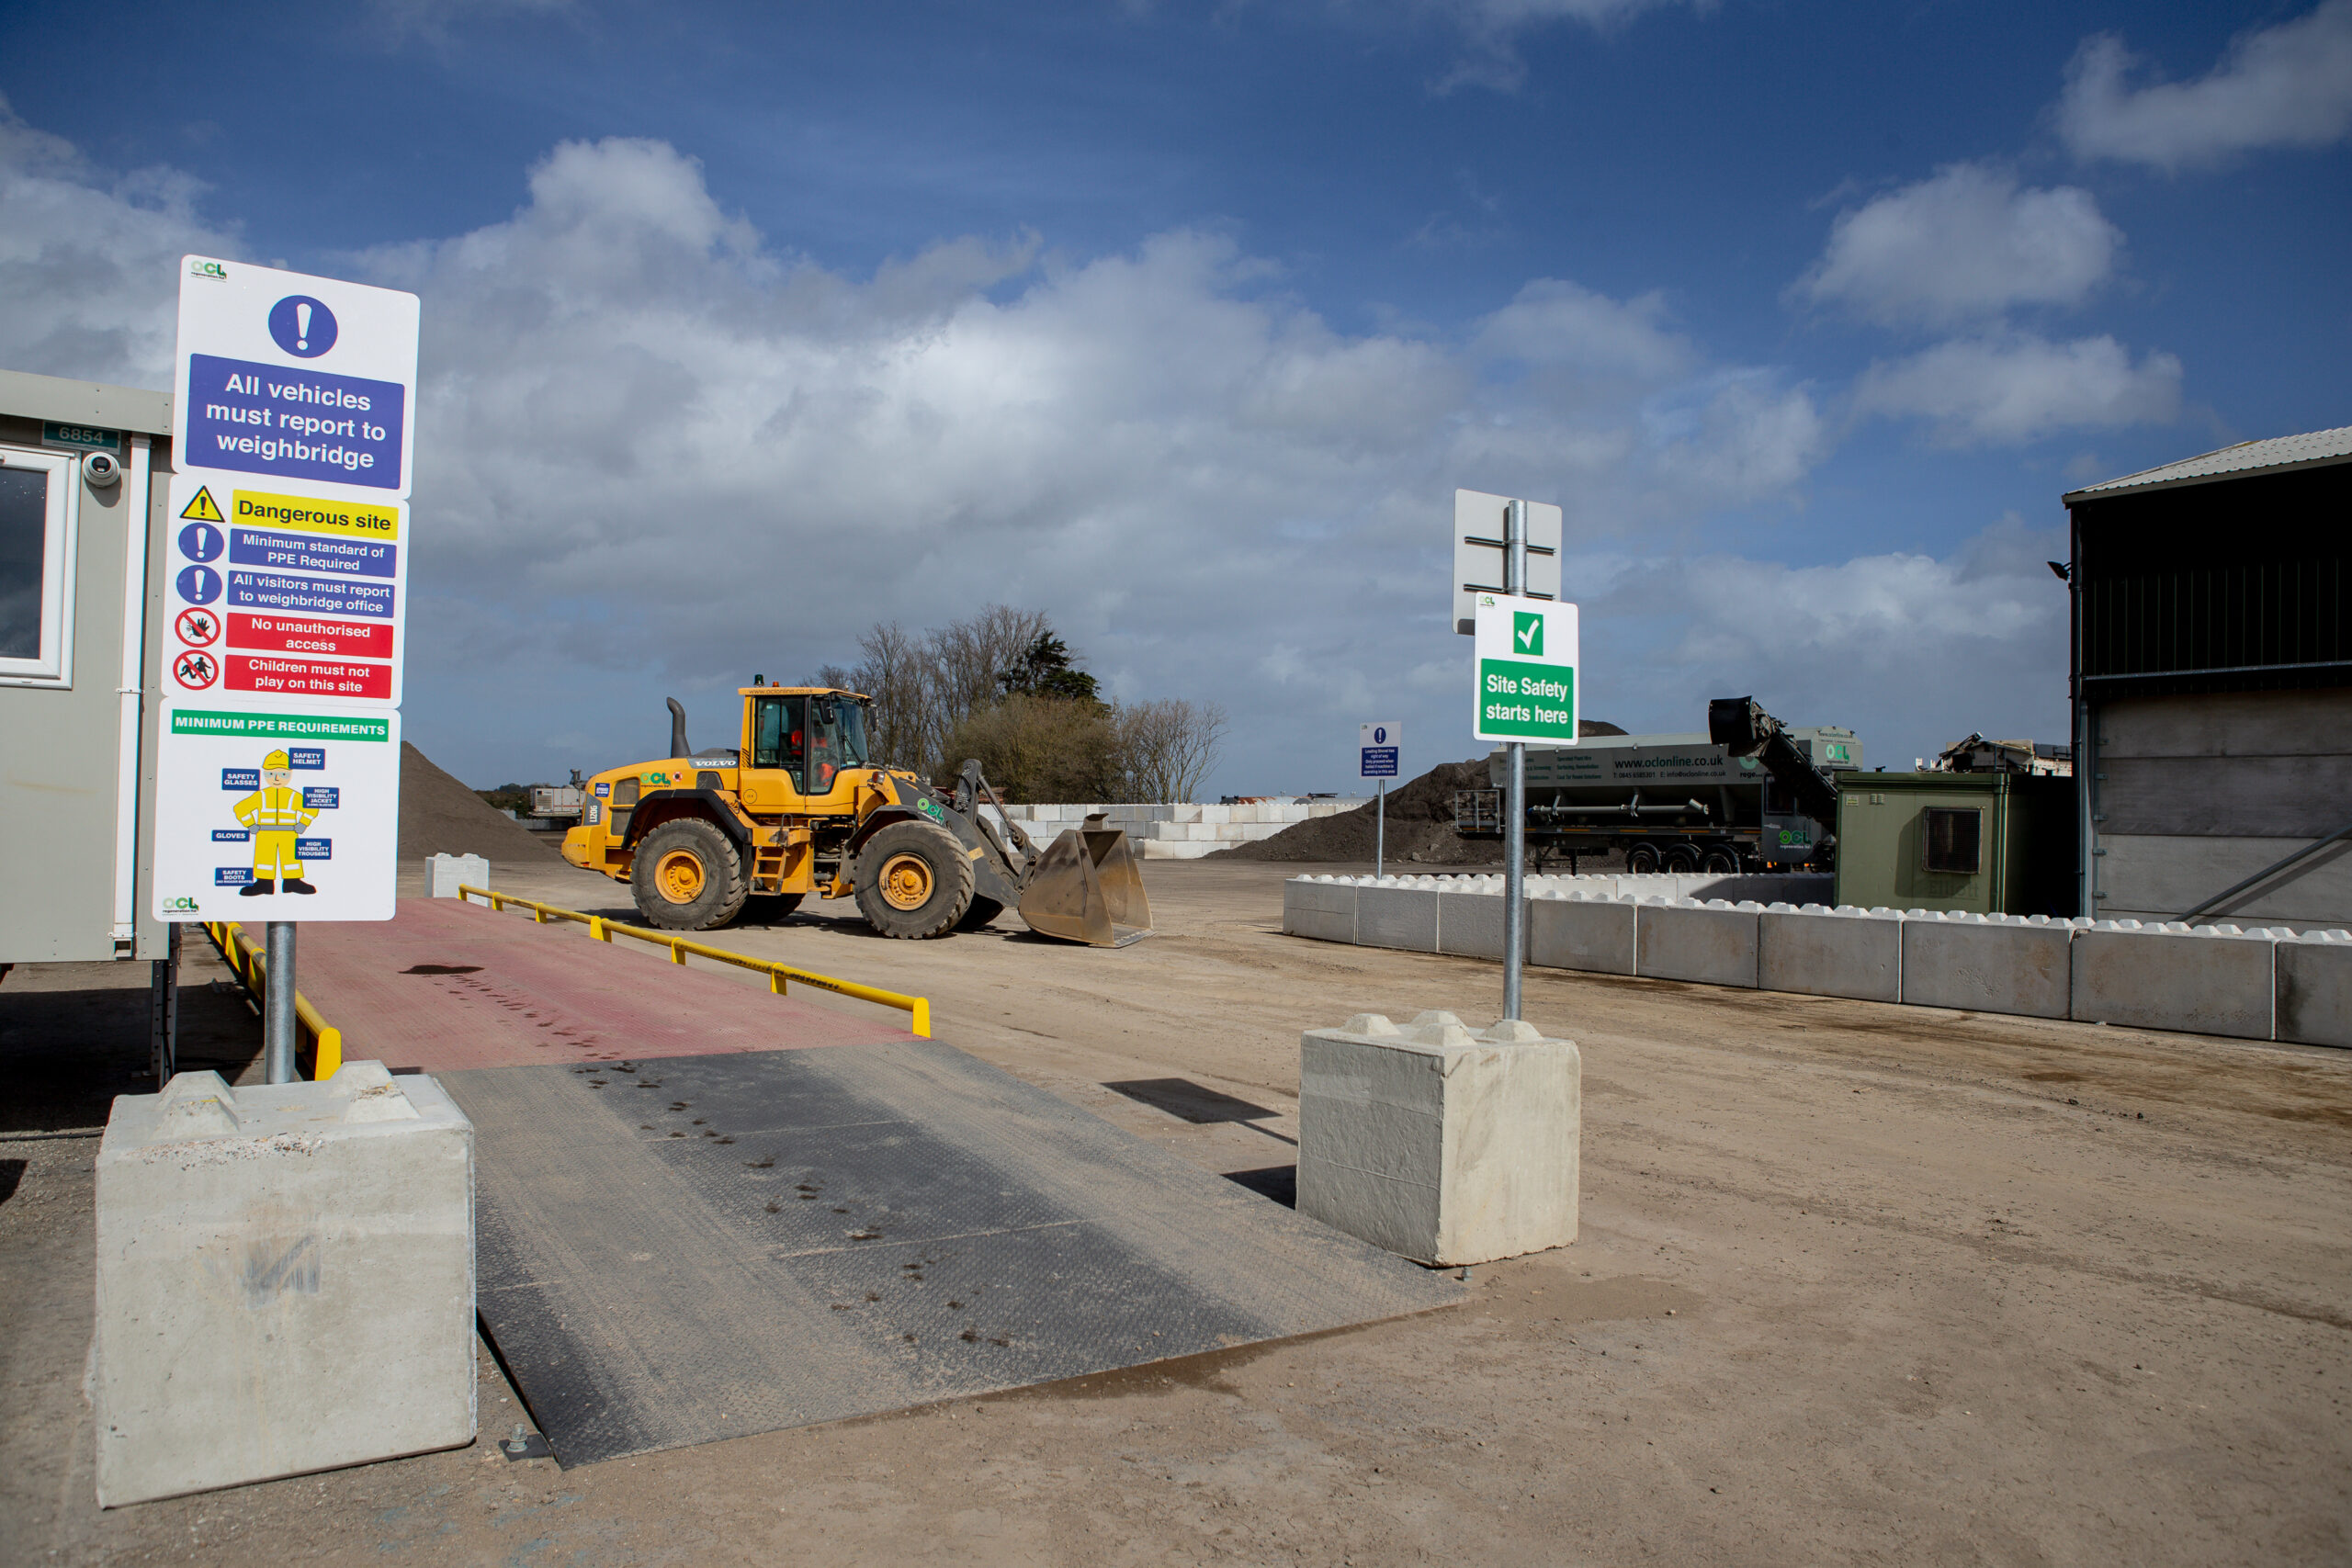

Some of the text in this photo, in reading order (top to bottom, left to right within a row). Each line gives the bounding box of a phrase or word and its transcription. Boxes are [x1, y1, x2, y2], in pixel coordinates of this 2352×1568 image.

[191, 261, 227, 278] OCL
[224, 373, 371, 412] All vehicles
[206, 402, 386, 442] must report to
[59, 426, 103, 444] 6854
[217, 432, 375, 470] weighbridge
[239, 500, 391, 530] Dangerous site
[243, 534, 385, 558] Minimum standard of
[267, 552, 360, 572] PPE Required
[233, 574, 390, 599] All visitors must report
[239, 591, 384, 613] to weighbridge office
[252, 617, 370, 637] No unauthorised
[286, 638, 336, 652] access
[249, 660, 369, 678] Children must not
[255, 677, 363, 692] play on this site
[1487, 673, 1567, 702] Site Safety
[1487, 703, 1568, 724] starts here
[175, 716, 386, 736] MINIMUM PPE REQUIREMENTS
[1614, 755, 1723, 769] www.oclonline.co.uk
[1826, 744, 1849, 761] OCL
[640, 773, 671, 785] OCL
[1667, 770, 1725, 778] info@oclonline.co.uk
[918, 798, 944, 825] OCL
[1779, 830, 1812, 846] OCL
[163, 897, 199, 911] OCL
